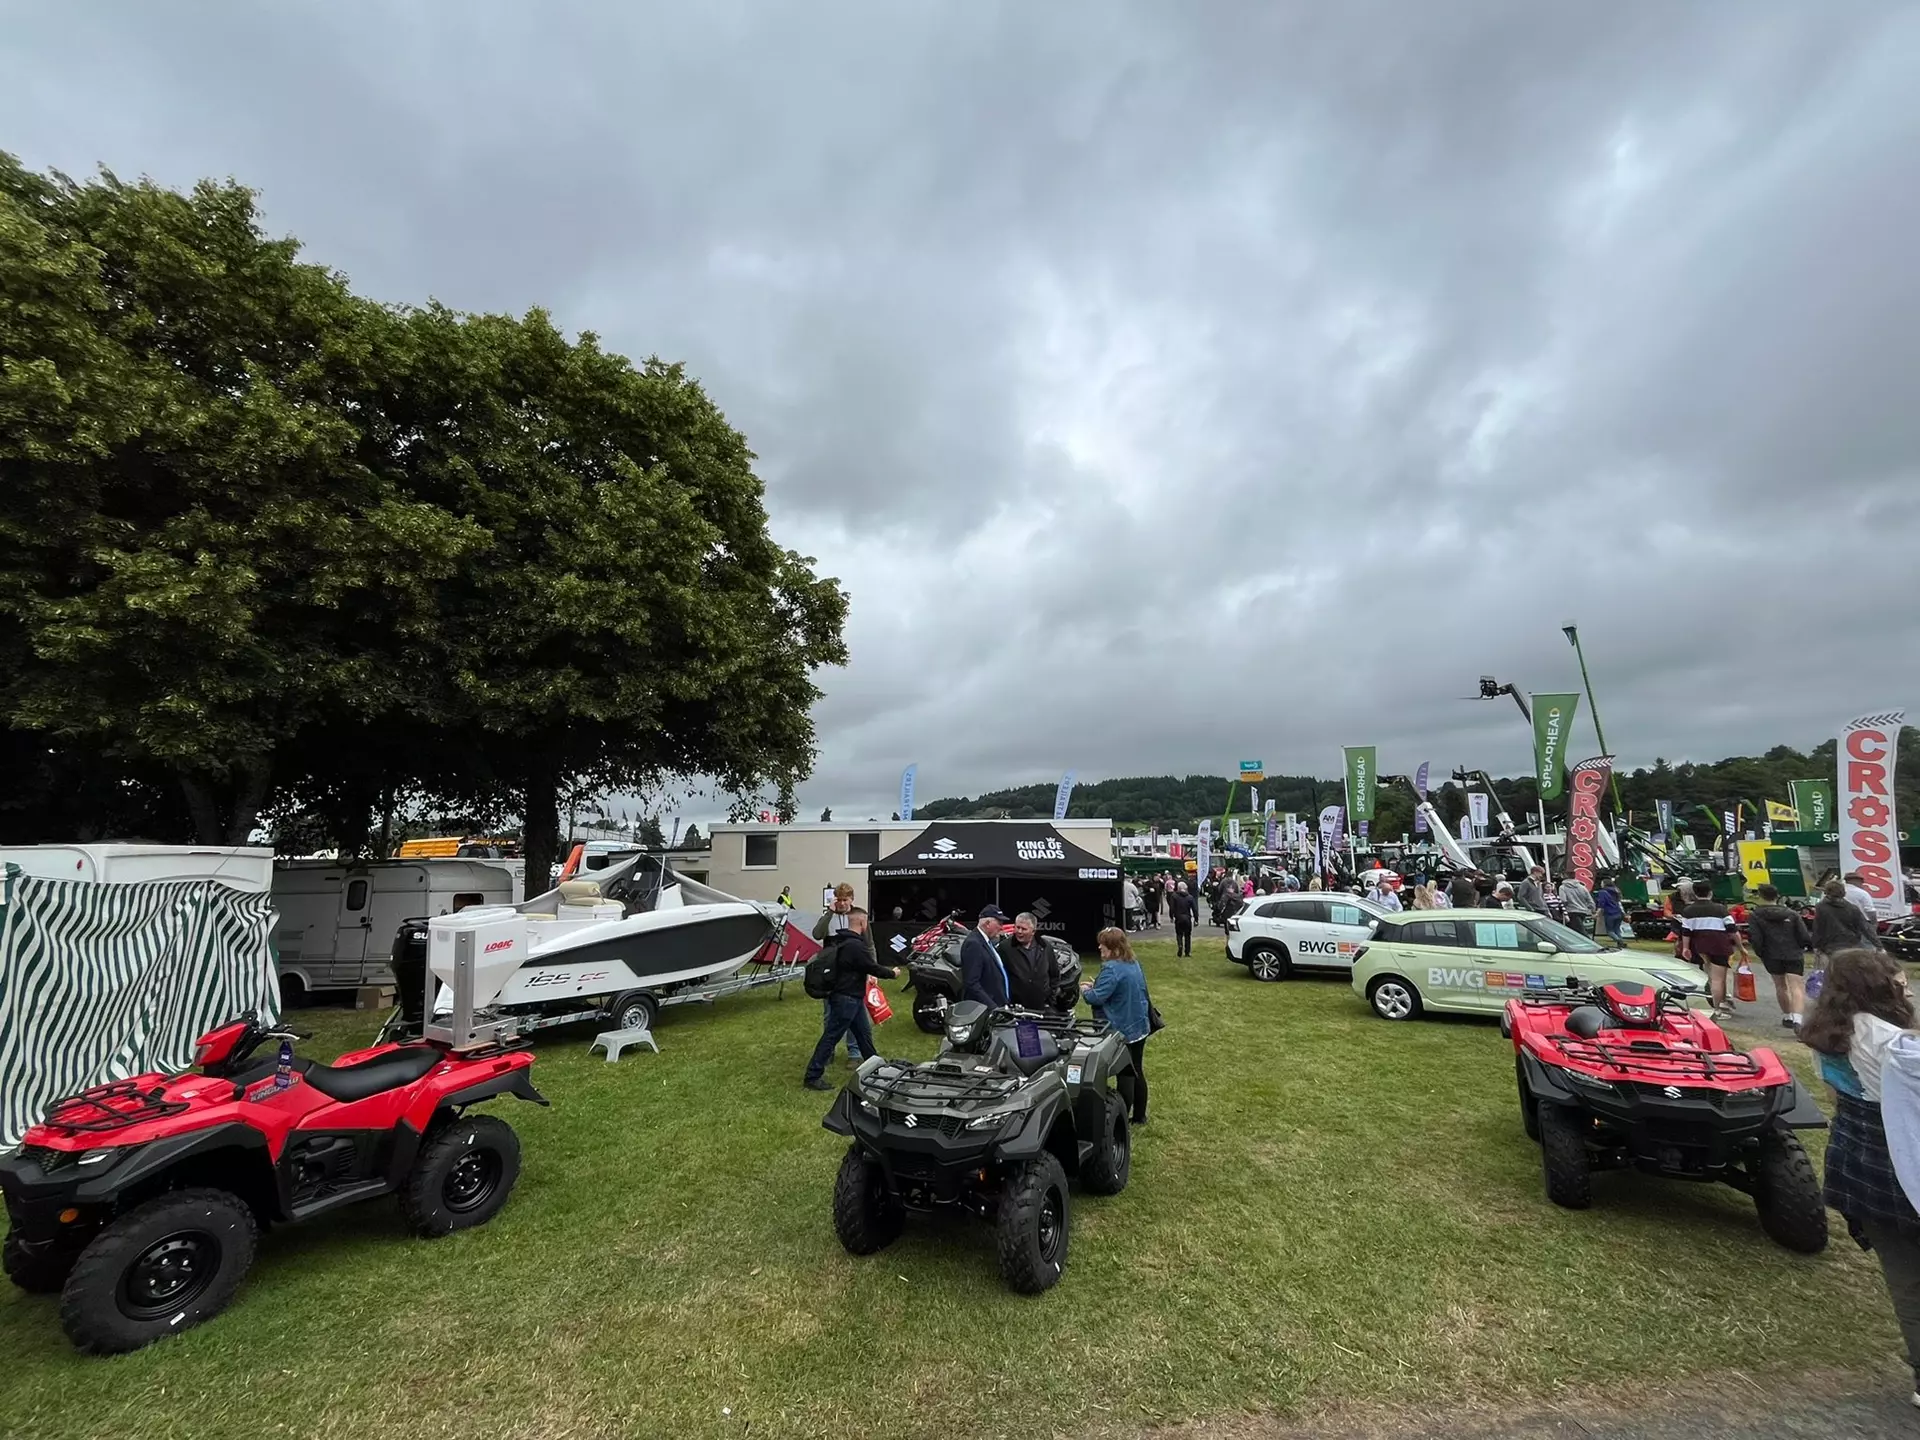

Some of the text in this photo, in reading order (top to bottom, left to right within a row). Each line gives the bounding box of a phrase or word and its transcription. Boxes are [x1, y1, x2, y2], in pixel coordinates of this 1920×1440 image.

[1356, 756, 1366, 813] SPEARHEAD
[1845, 729, 1895, 899] CROSS
[1571, 769, 1602, 893] CROSS
[1015, 840, 1062, 850] KING OF
[1018, 850, 1066, 861] QUADS
[874, 867, 927, 877] atv.suzuki.co.uk
[1035, 921, 1066, 931] ZUKI
[485, 939, 514, 951] LOGIC
[1299, 940, 1336, 954] BWG
[1427, 967, 1484, 988] BWG
